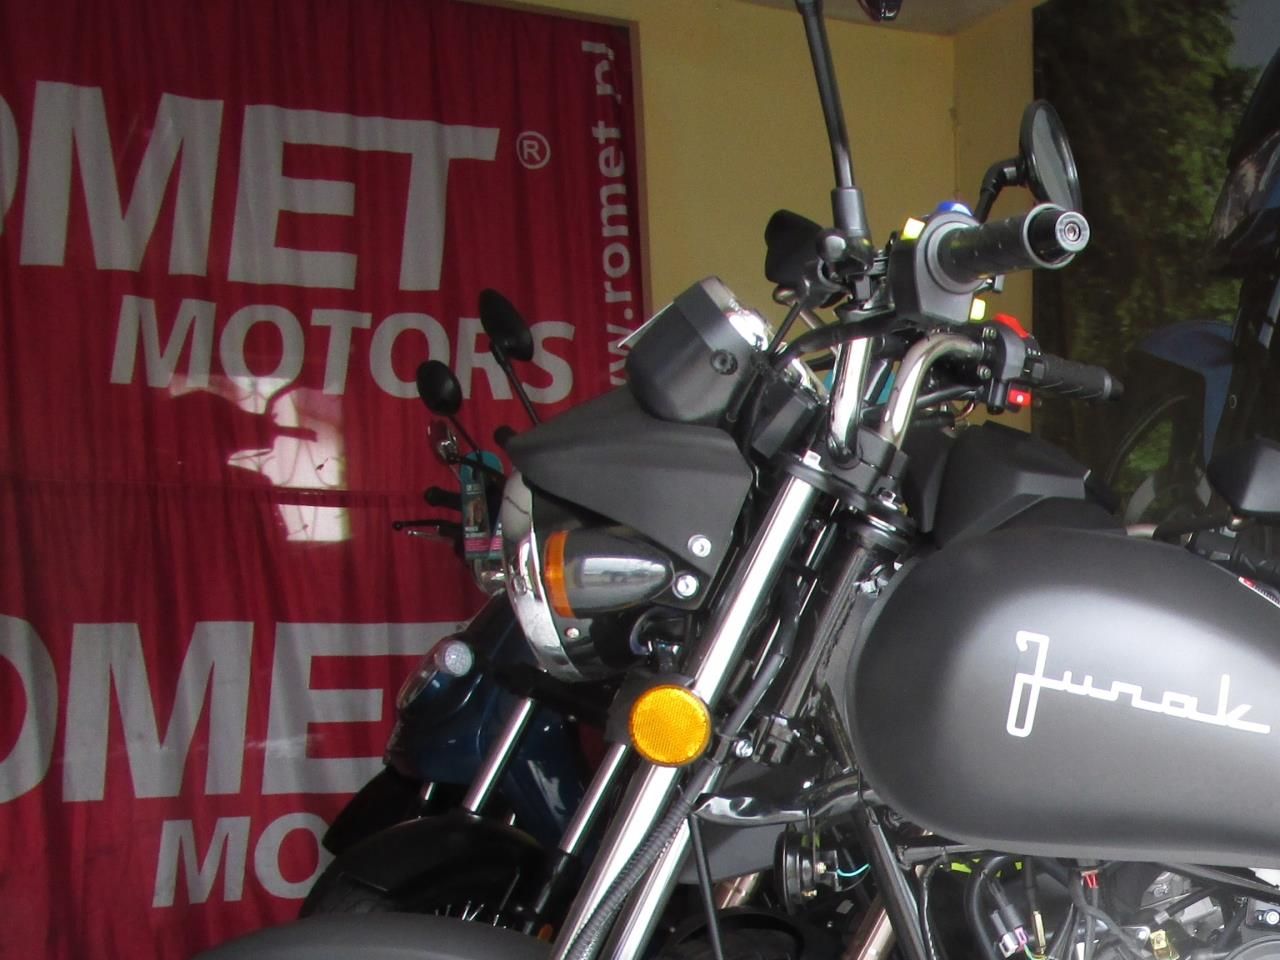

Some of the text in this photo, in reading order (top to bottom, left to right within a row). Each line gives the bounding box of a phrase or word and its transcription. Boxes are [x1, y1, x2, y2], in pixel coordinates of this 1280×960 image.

[0, 80, 499, 291] MET
[110, 294, 576, 404] MOTORS
[0, 613, 470, 803] ME
[1006, 630, 1271, 737] Junak
